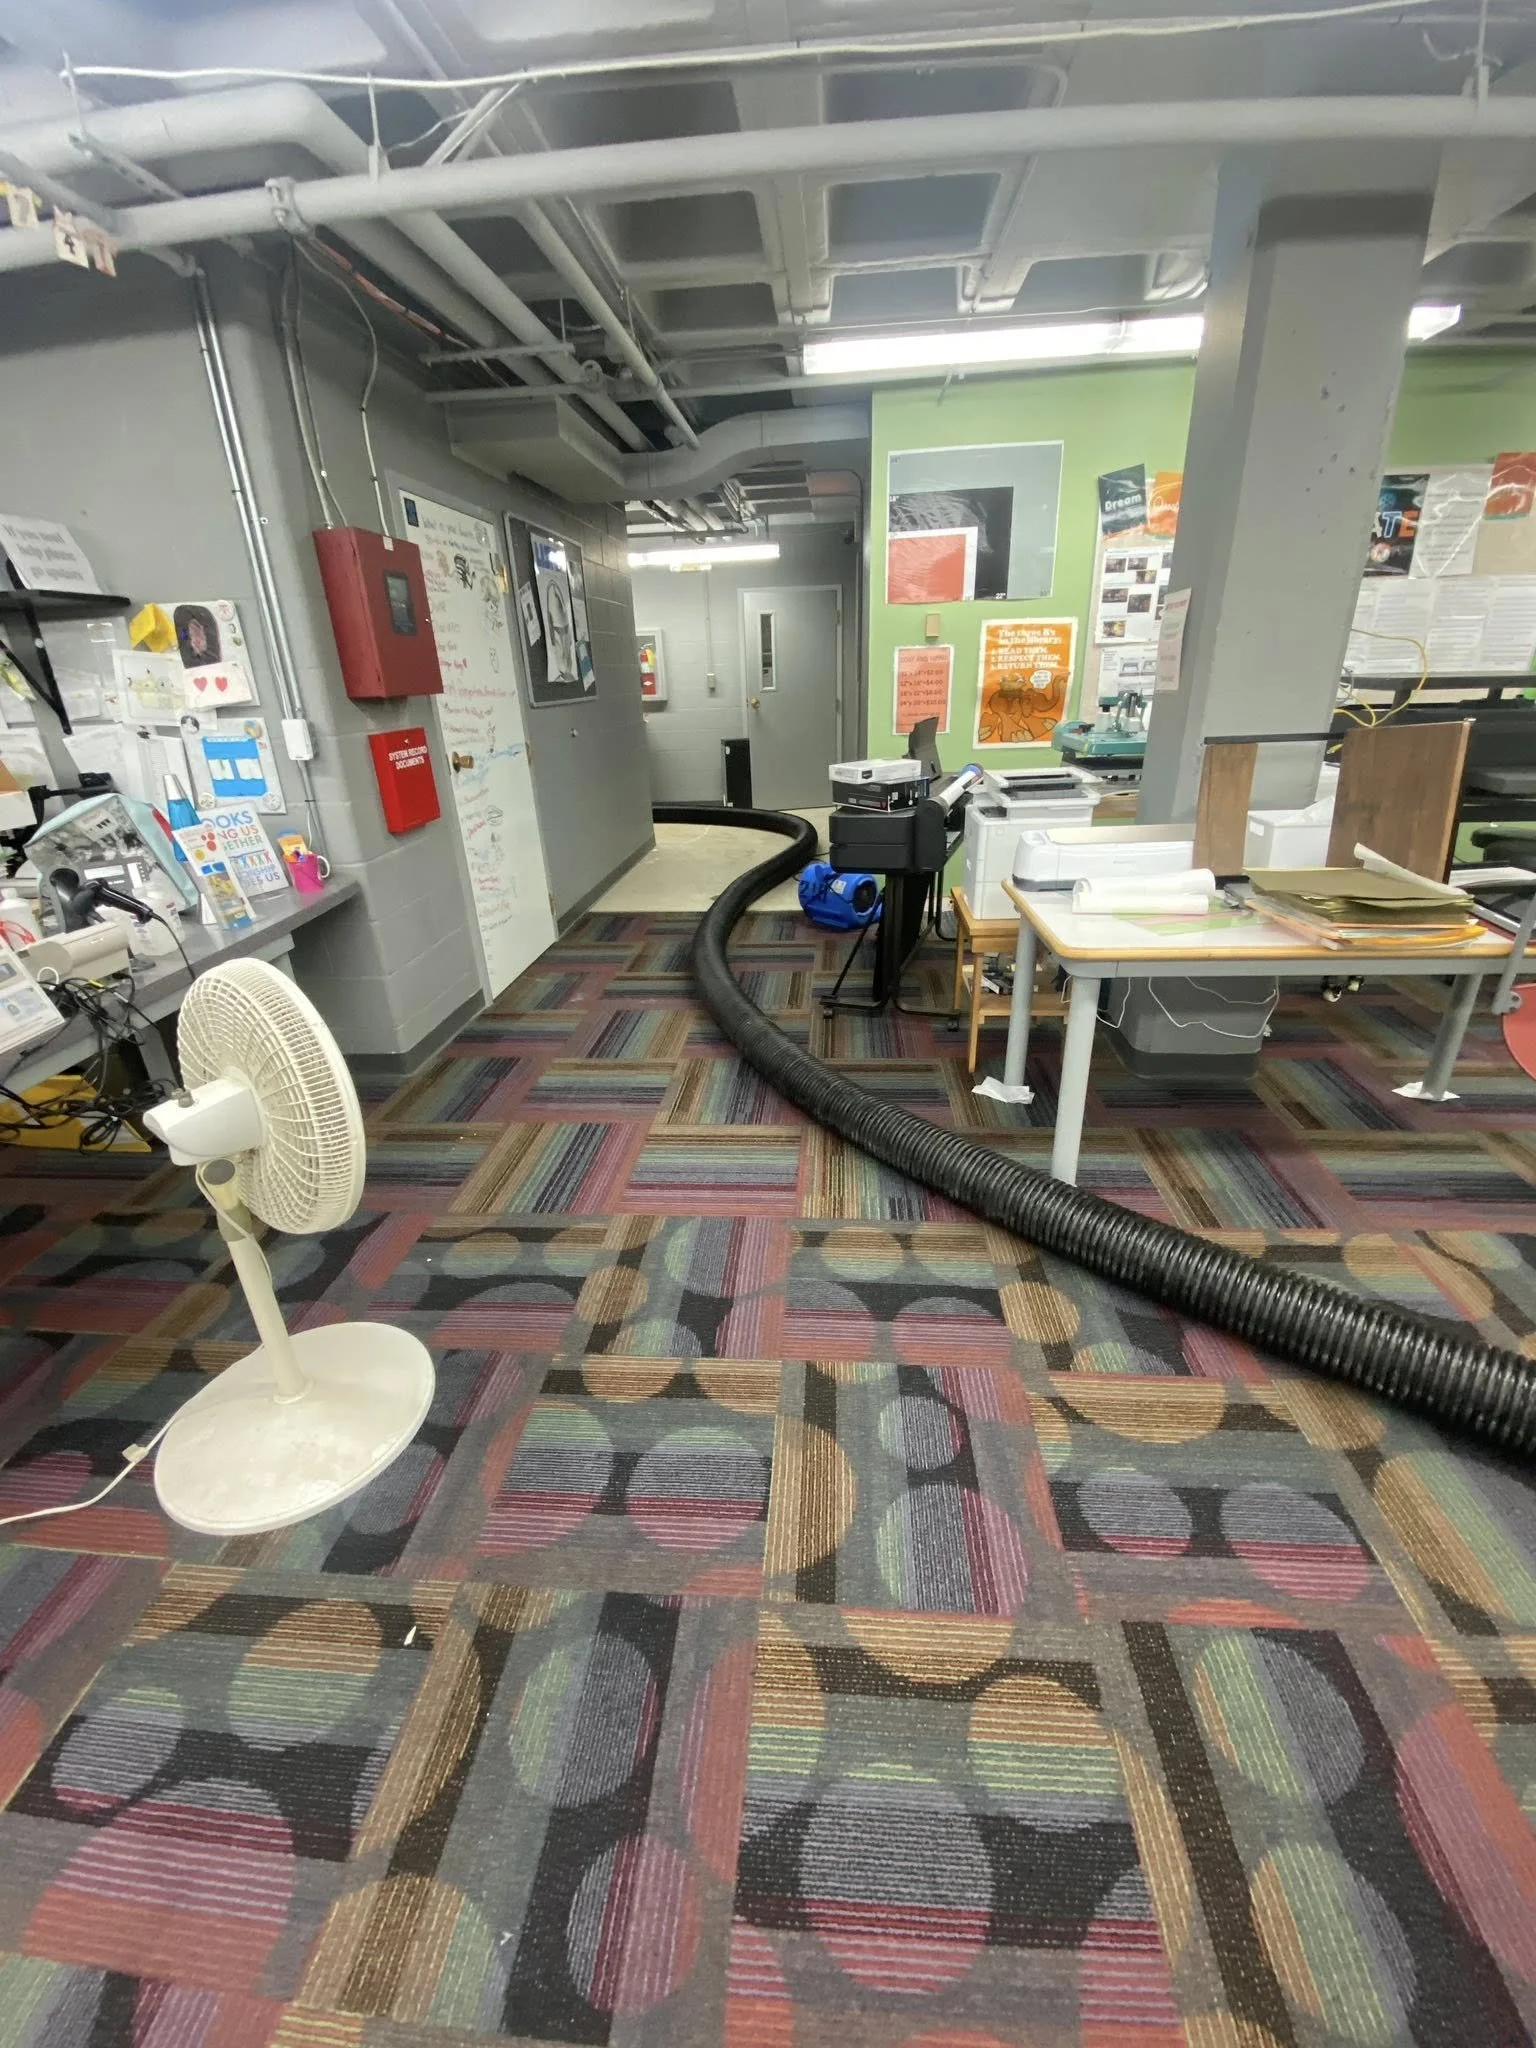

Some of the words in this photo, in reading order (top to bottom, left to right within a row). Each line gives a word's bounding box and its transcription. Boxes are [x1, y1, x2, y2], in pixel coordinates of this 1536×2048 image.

[1104, 493, 1143, 512] Dream
[1372, 510, 1421, 539] ATE
[998, 629, 1016, 638] The
[1016, 629, 1042, 638] three
[1009, 637, 1026, 645] the
[998, 647, 1023, 655] READ
[997, 654, 1034, 663] RESPECT
[997, 662, 1033, 670] RETURN
[388, 749, 408, 762] SYSTEM
[408, 745, 428, 757] RECORD
[395, 755, 425, 770] DOCUMENTS
[240, 824, 260, 837] US
[223, 834, 264, 851] ETHER
[265, 871, 281, 882] US
